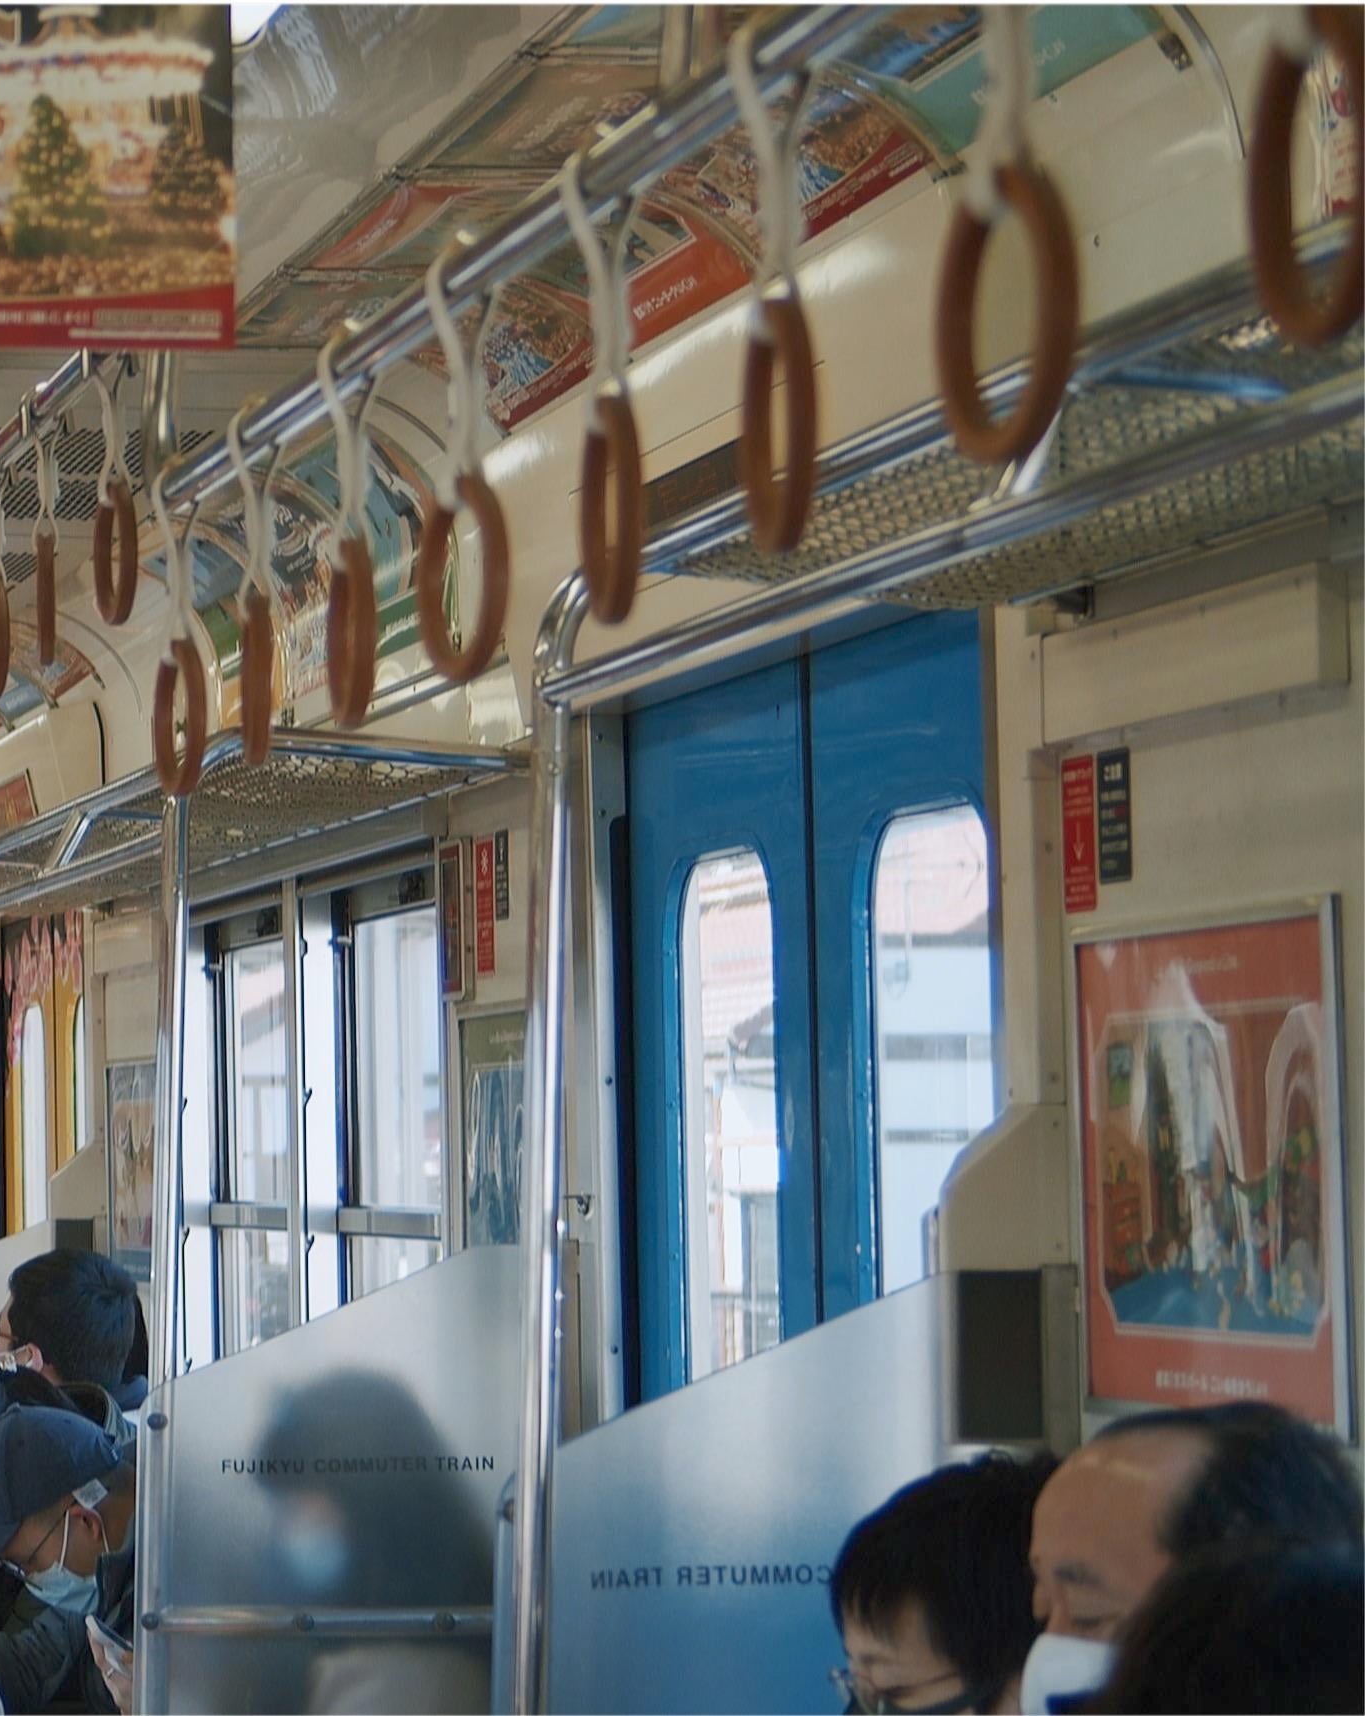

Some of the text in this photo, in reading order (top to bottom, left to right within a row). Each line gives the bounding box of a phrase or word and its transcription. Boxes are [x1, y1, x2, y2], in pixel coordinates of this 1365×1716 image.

[221, 1456, 495, 1475] FUJIKYU COMMUTER TRAIN
